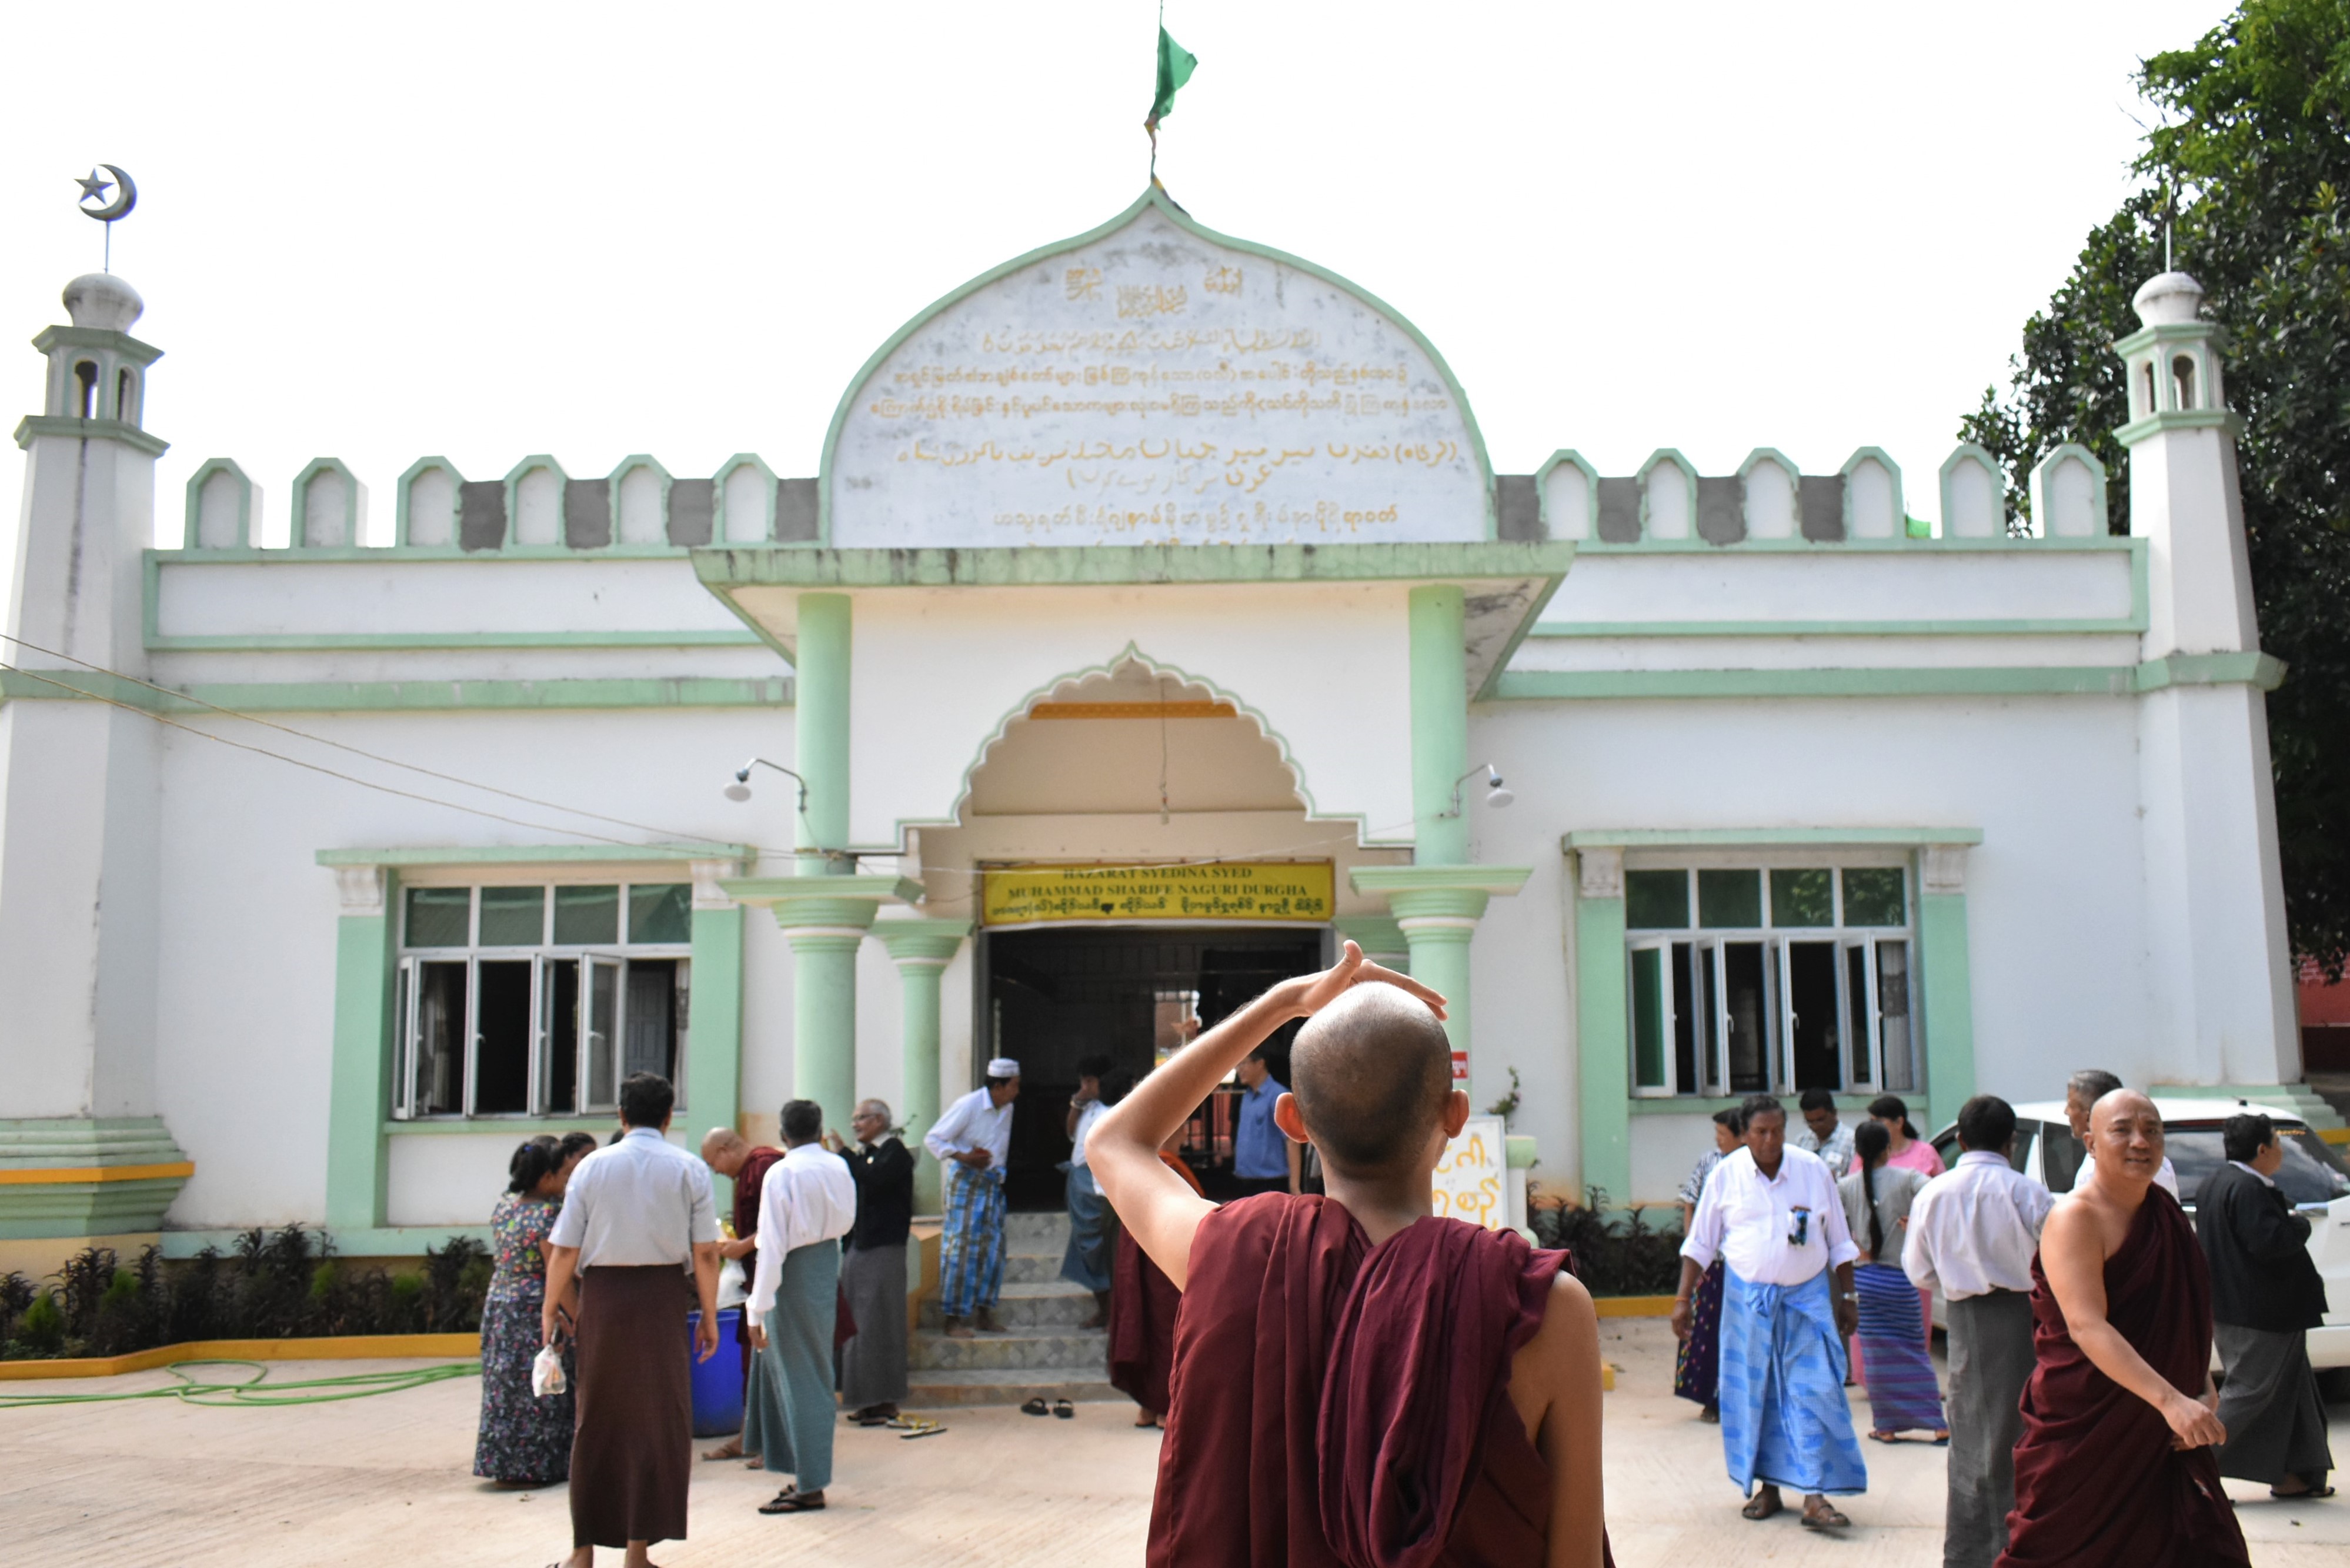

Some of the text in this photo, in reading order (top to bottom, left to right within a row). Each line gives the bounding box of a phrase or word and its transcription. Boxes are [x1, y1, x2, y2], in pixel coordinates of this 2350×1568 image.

[1140, 868, 1208, 879] SYEDINA
[1212, 868, 1252, 878] SYED
[1008, 884, 1103, 899] MUHAMMAD
[1179, 883, 1239, 895] NAGURI
[1242, 883, 1307, 896] DURGHA
